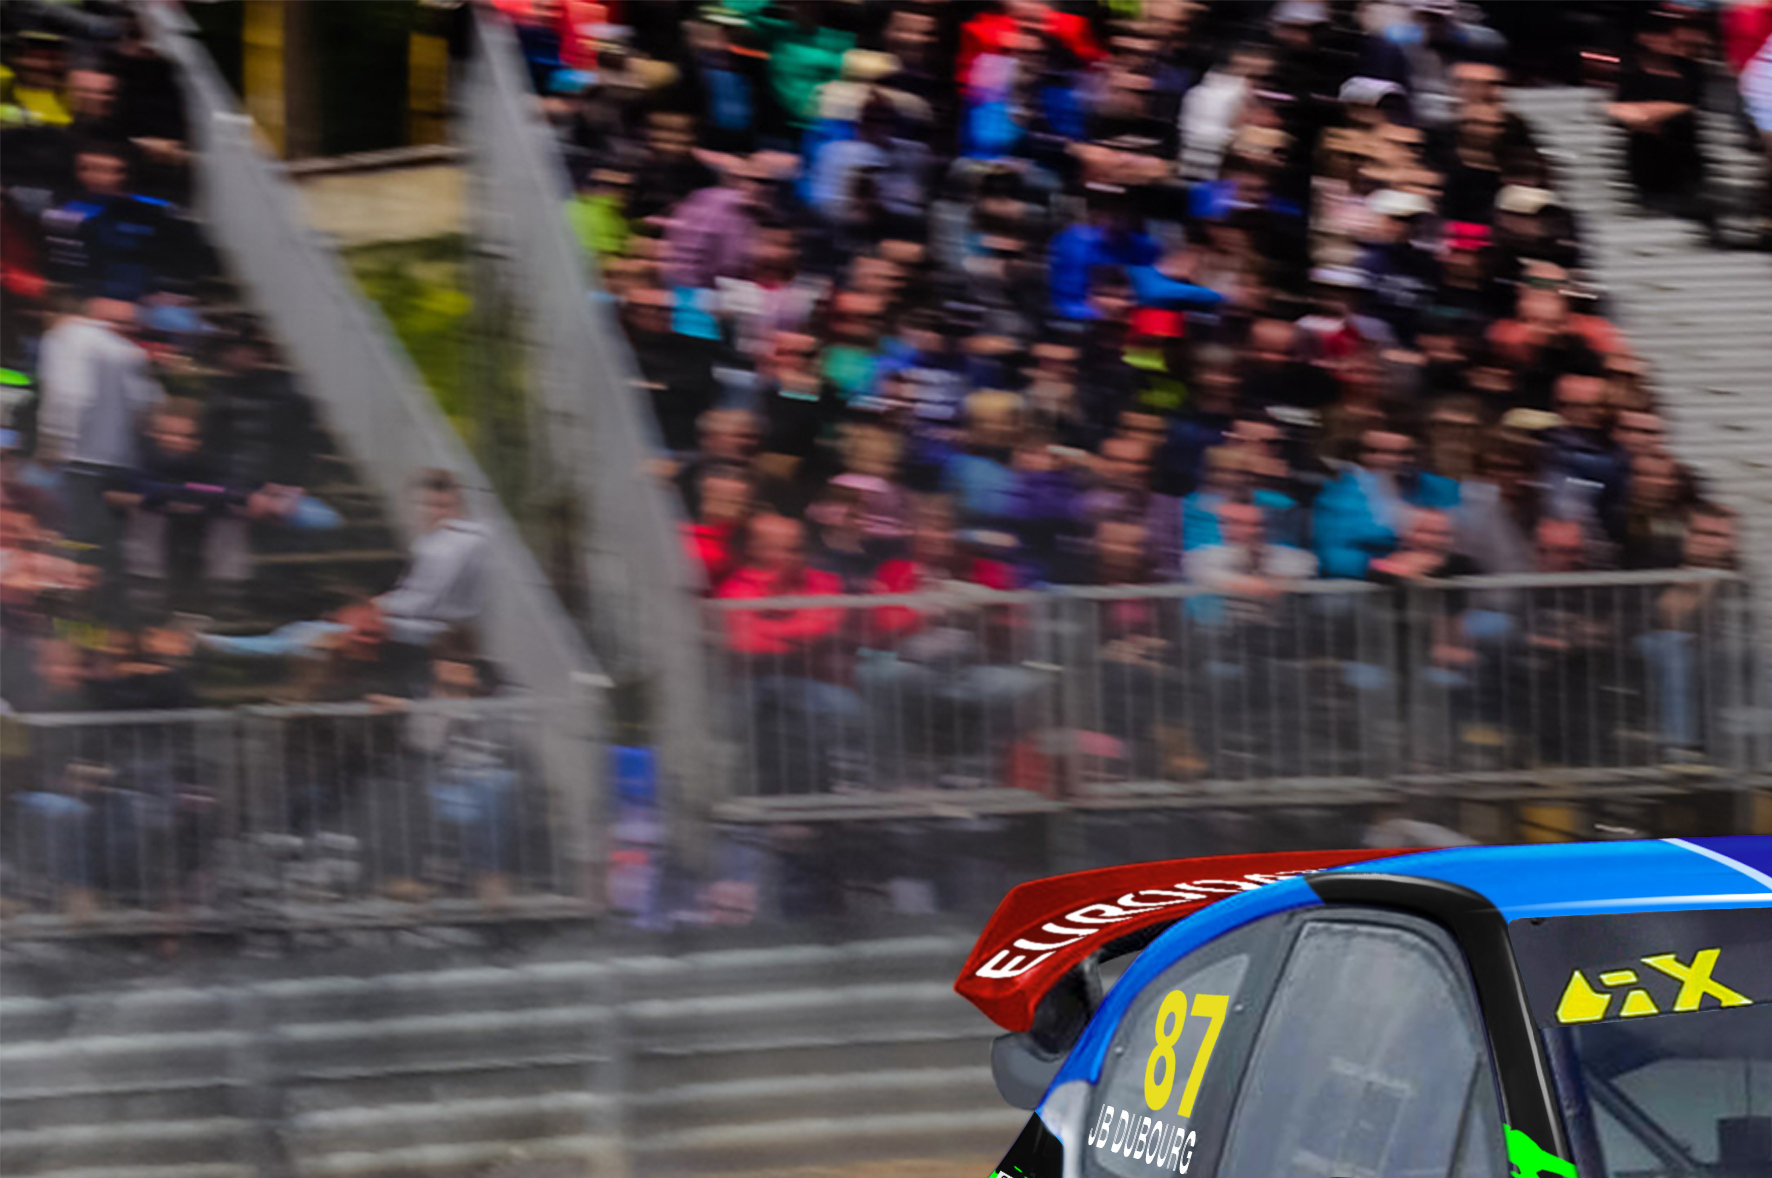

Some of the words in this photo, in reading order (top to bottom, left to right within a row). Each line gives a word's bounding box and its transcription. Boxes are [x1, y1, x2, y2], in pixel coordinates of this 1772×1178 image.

[975, 867, 1326, 978] EURODA
[1143, 989, 1230, 1118] 87
[1088, 1104, 1115, 1148] JB
[1111, 1109, 1196, 1174] DUBOURG
